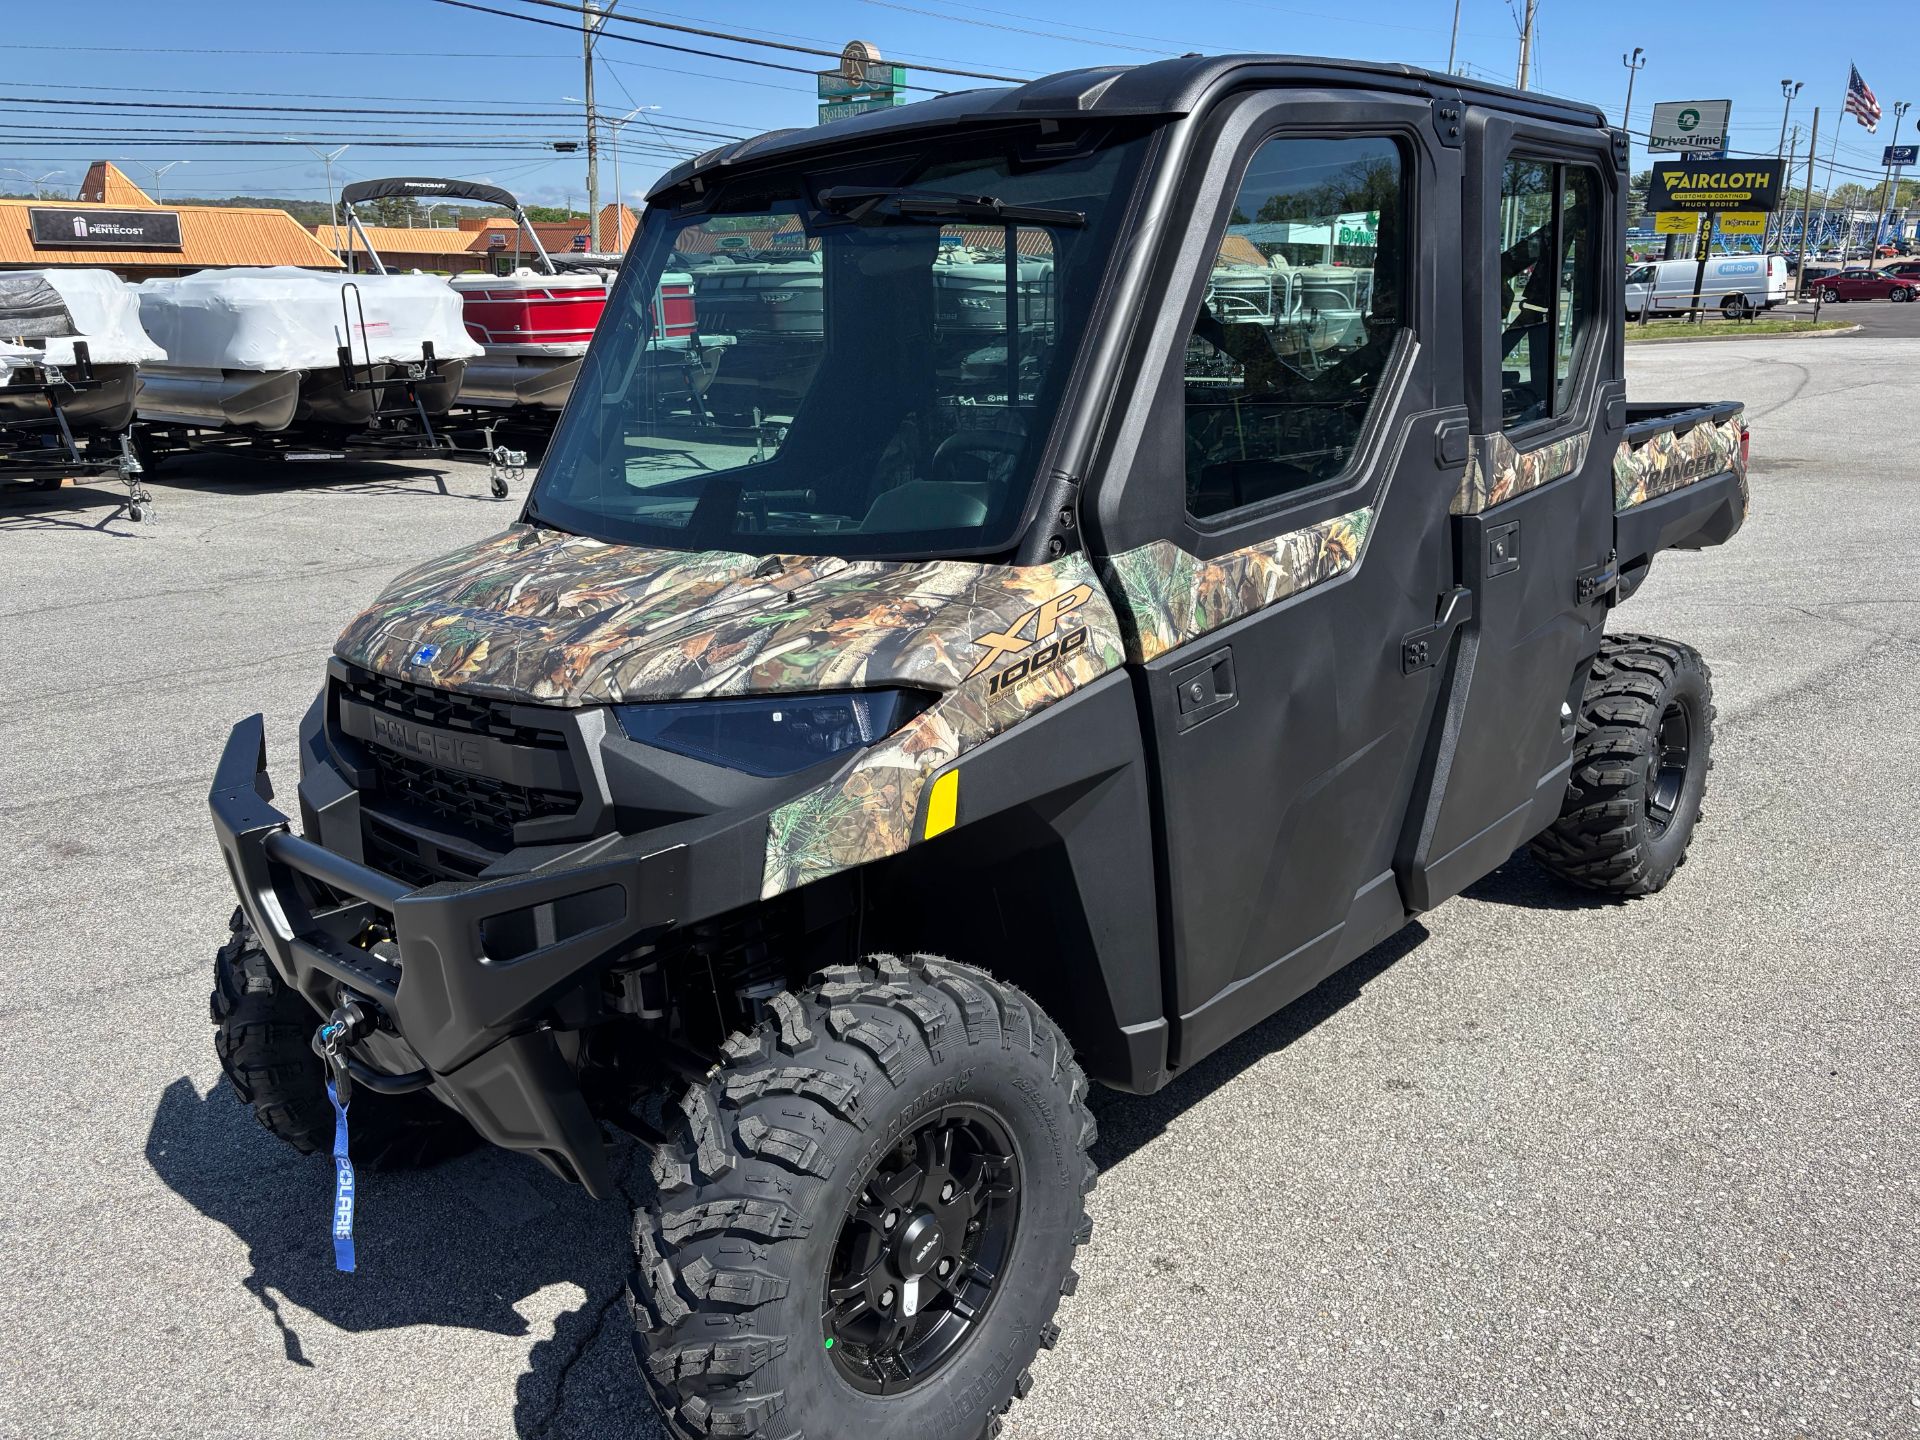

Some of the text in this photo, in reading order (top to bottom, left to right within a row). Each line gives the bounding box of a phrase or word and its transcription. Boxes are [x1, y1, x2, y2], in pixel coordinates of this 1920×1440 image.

[1651, 135, 1721, 147] DriveTime
[1662, 171, 1770, 191] FAIRCLOTH
[89, 226, 144, 235] PENTECOST
[1697, 220, 1711, 260] 8812
[1722, 263, 1755, 273] Hill-Rom
[1646, 452, 1718, 488] RANGER
[959, 583, 1095, 685] XP
[988, 626, 1088, 696] 1000
[373, 713, 483, 769] POLARIS
[336, 1156, 353, 1241] POLARIS
